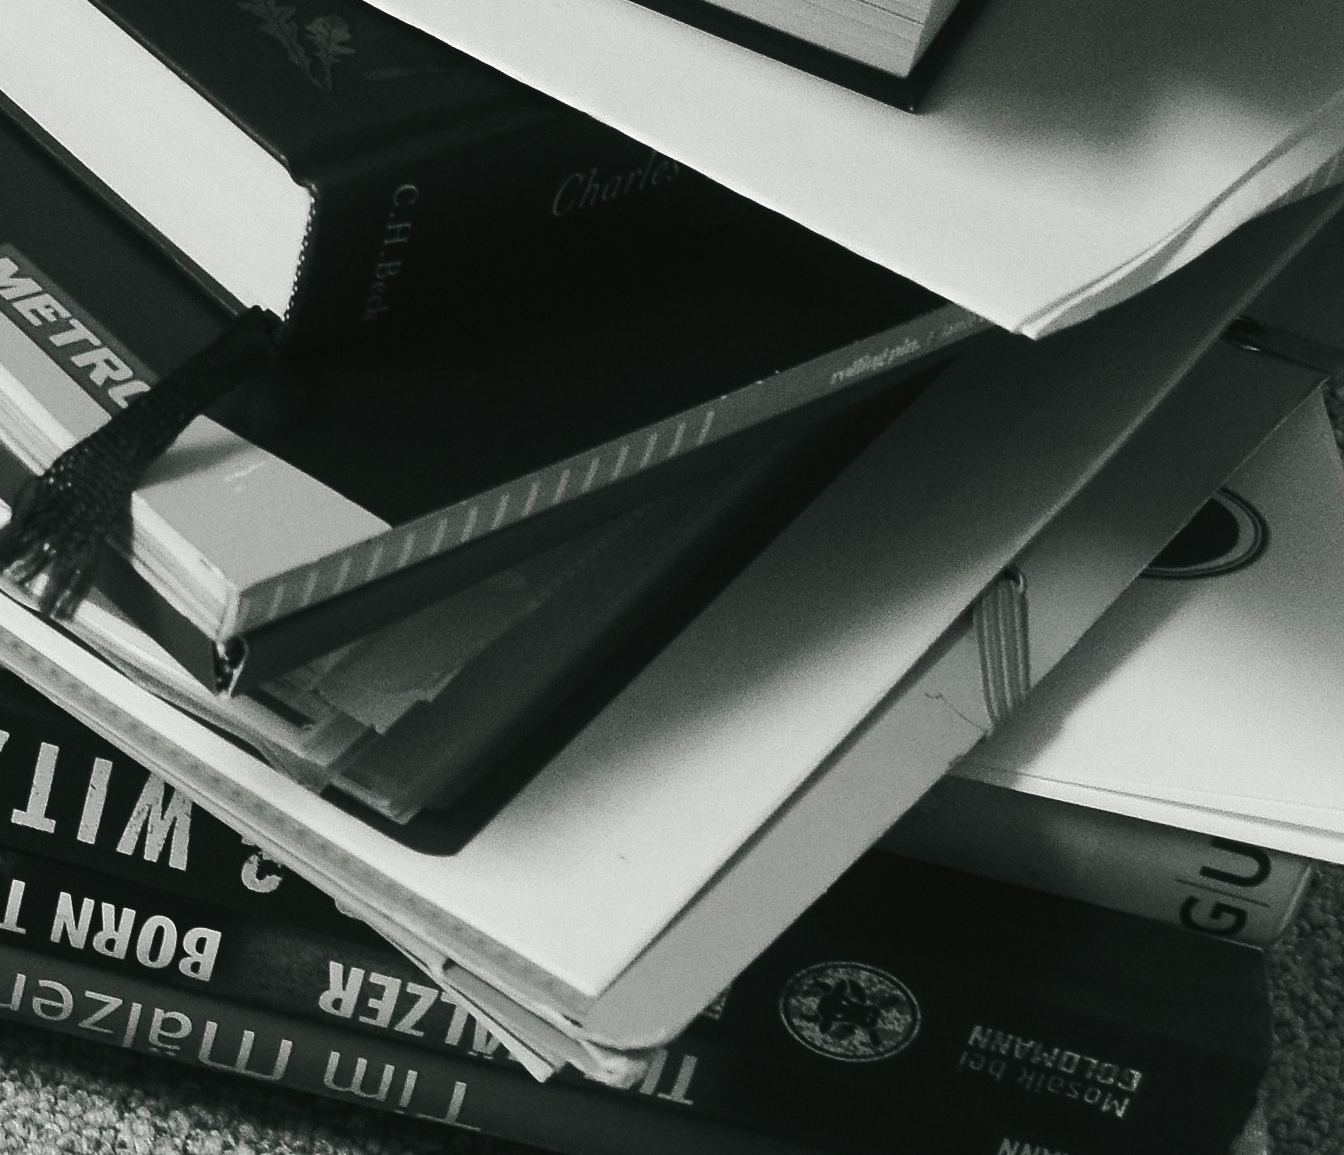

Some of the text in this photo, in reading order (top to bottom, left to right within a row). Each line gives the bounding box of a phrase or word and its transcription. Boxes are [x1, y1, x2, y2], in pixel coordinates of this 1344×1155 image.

[49, 892, 222, 982] BORN
[323, 1050, 482, 1131] Tim
[956, 1050, 1131, 1120] Mosaik bei
[967, 1024, 1144, 1093] GOLDMANN
